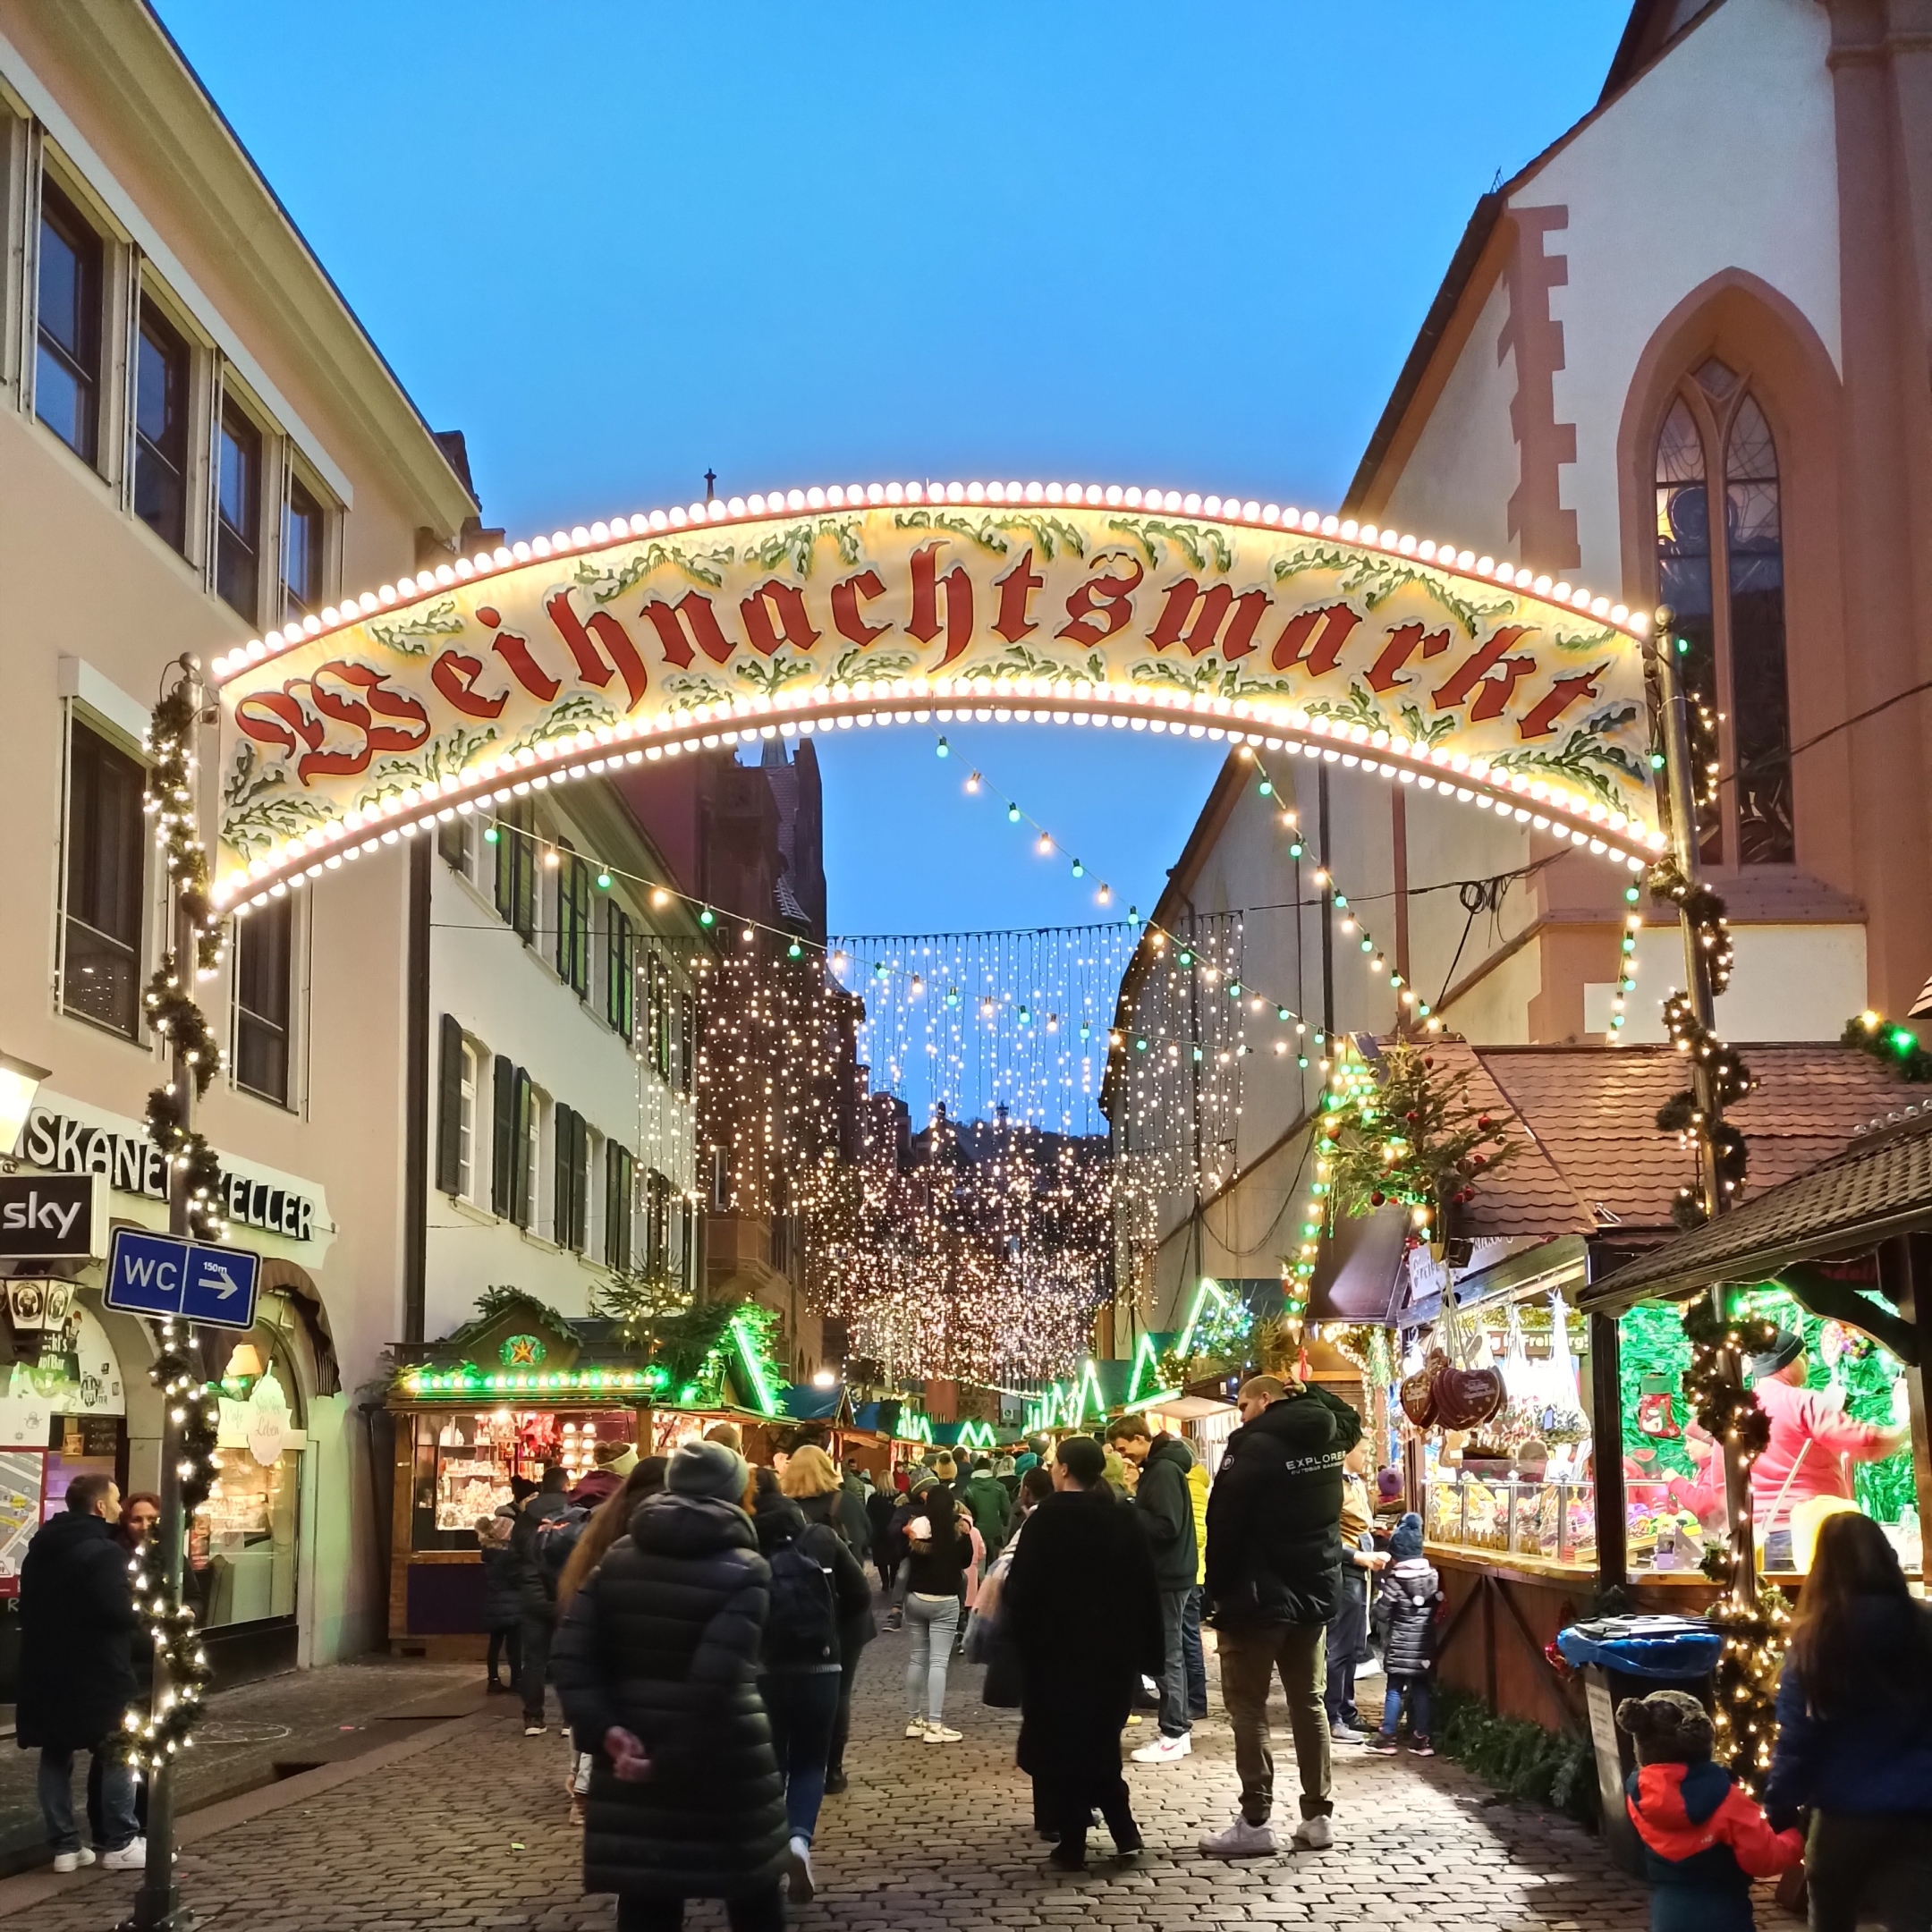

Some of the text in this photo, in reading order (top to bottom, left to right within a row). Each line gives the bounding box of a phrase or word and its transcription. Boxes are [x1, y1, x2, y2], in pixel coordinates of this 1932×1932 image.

[235, 542, 1609, 784] Weihnachtsmarkt
[3, 1191, 82, 1239] sky
[124, 1254, 227, 1291] WC 150m
